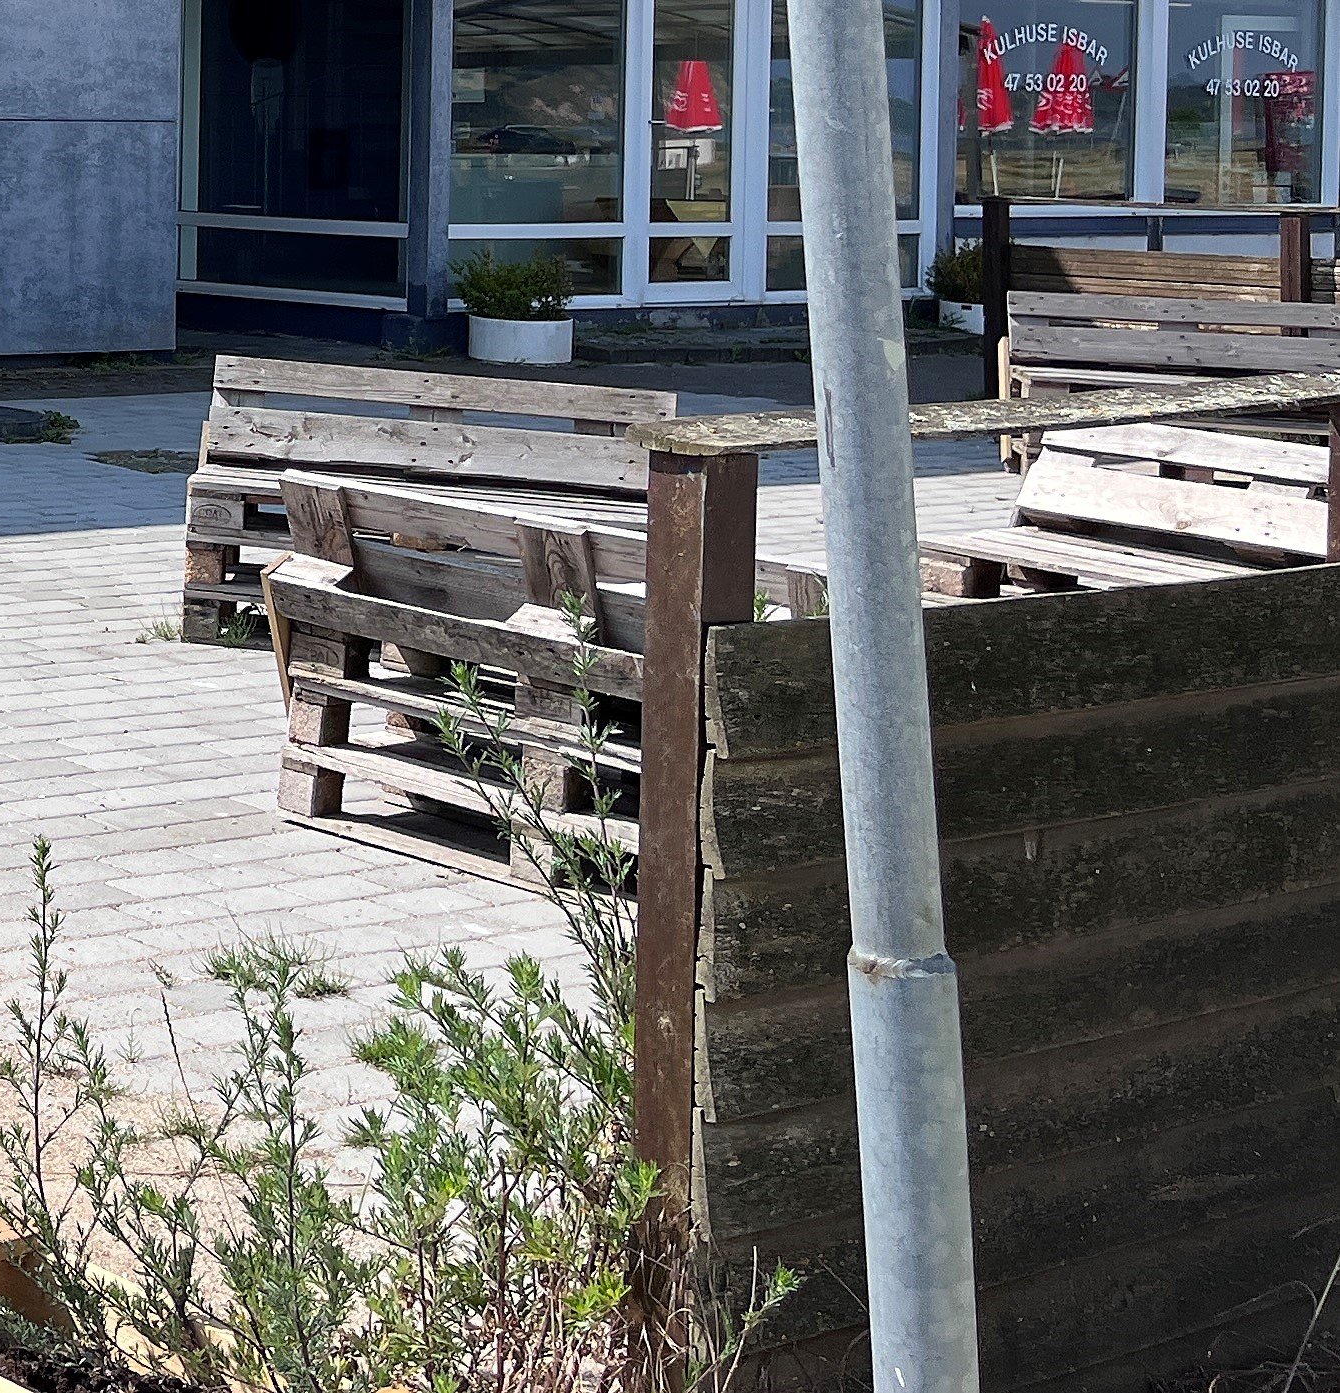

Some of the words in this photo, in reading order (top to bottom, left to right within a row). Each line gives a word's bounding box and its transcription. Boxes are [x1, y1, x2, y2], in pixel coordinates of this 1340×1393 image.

[983, 23, 1058, 65] KULHUSE
[1062, 25, 1108, 66] ISBAR
[1188, 31, 1254, 70] KULHUSE
[1259, 34, 1298, 74] ISBAR
[1004, 73, 1020, 92] 47
[1025, 73, 1043, 92] 53
[1047, 73, 1064, 92] 02
[1069, 73, 1087, 92] 20
[1206, 79, 1221, 96] 47
[1225, 79, 1241, 96] 53
[1244, 80, 1260, 97] 02
[1263, 80, 1279, 97] 20
